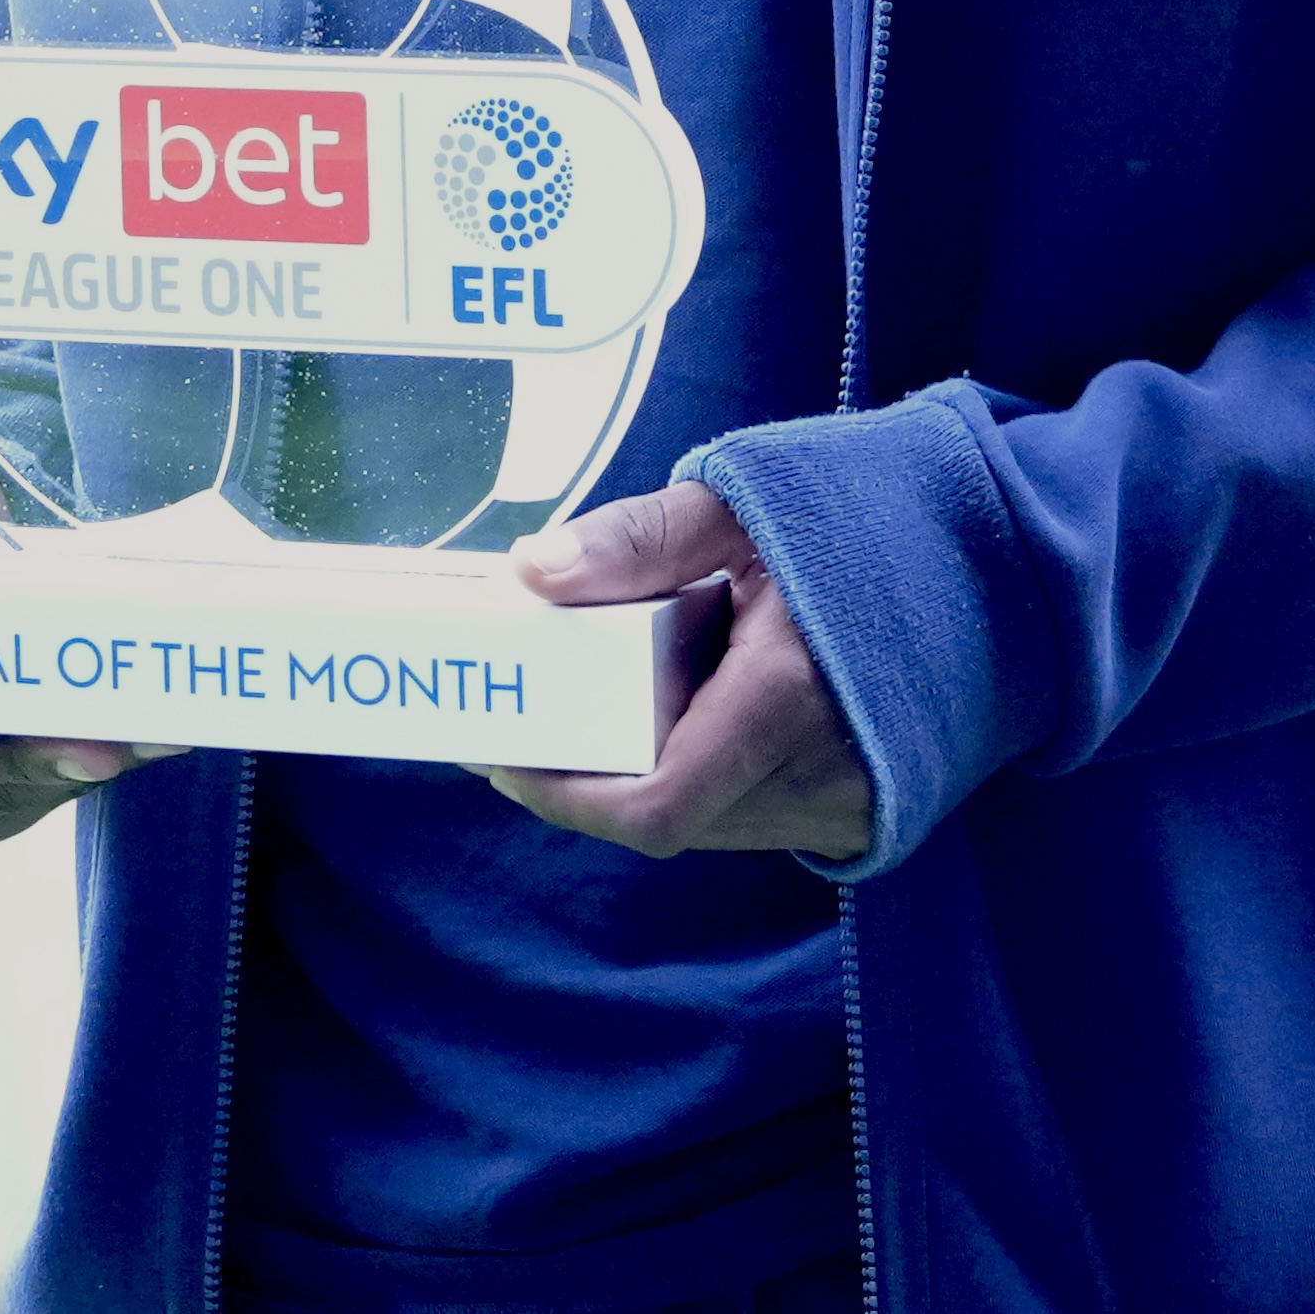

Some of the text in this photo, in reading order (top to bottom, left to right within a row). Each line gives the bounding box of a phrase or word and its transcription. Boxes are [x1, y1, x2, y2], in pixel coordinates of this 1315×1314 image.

[146, 98, 345, 208] bet
[200, 257, 324, 320] ONE
[451, 265, 564, 328] EFL
[56, 636, 138, 691] OF
[149, 641, 267, 699] THE
[288, 650, 525, 715] MONTH
